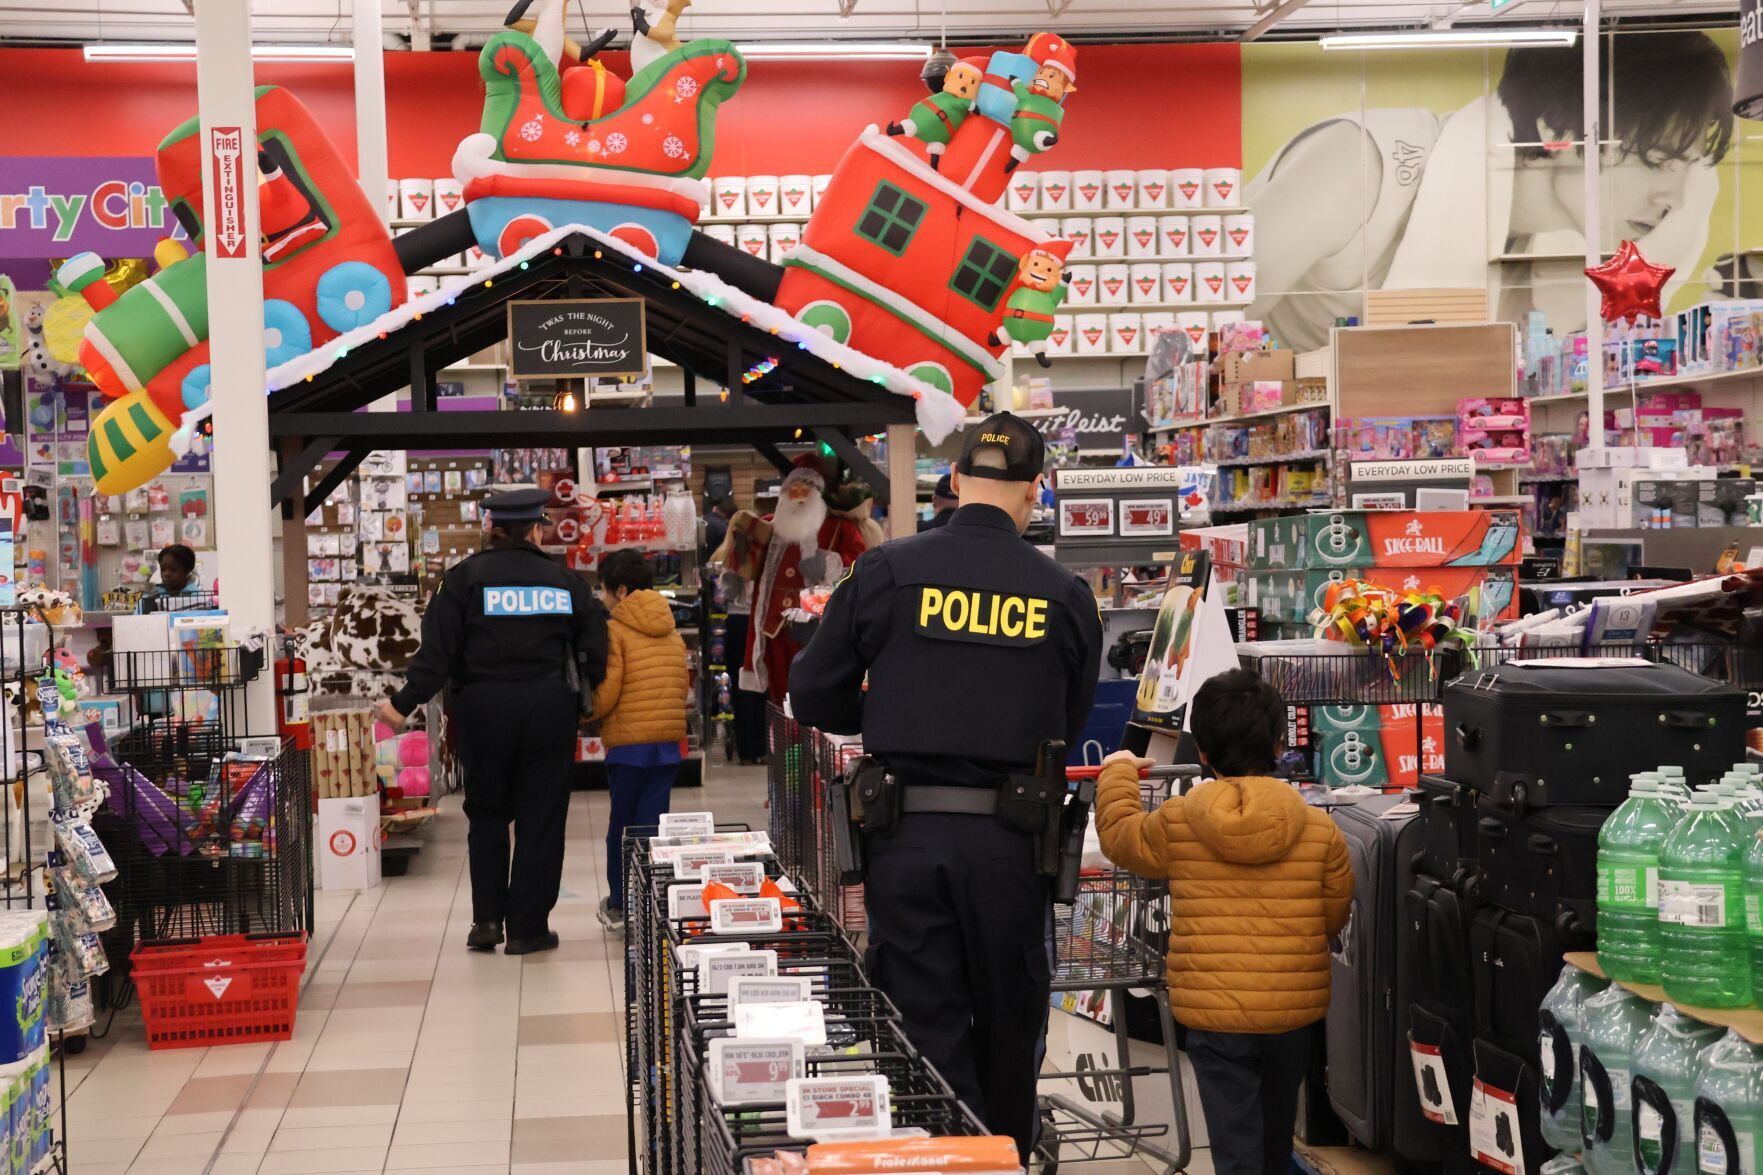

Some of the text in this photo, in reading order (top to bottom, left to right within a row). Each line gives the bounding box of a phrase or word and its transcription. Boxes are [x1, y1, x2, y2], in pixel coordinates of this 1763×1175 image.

[216, 138, 238, 150] FIRE
[223, 154, 236, 247] EXTINGUISHER
[567, 312, 586, 320] THE
[587, 313, 615, 331] NIGHT
[564, 328, 592, 336] BEFORE
[530, 338, 630, 364] Christmas
[981, 433, 1010, 446] POLICE
[1358, 463, 1470, 477] EVERYDAY LOW PRICE
[1063, 472, 1176, 485] EVERYDAY LOW PRICE
[1384, 537, 1448, 556] SKEE-BALL
[487, 590, 569, 612] POLICE
[920, 587, 1049, 639] POLICE
[1619, 610, 1630, 622] 13
[812, 1086, 838, 1094] STORE
[874, 1154, 951, 1168] Professional
